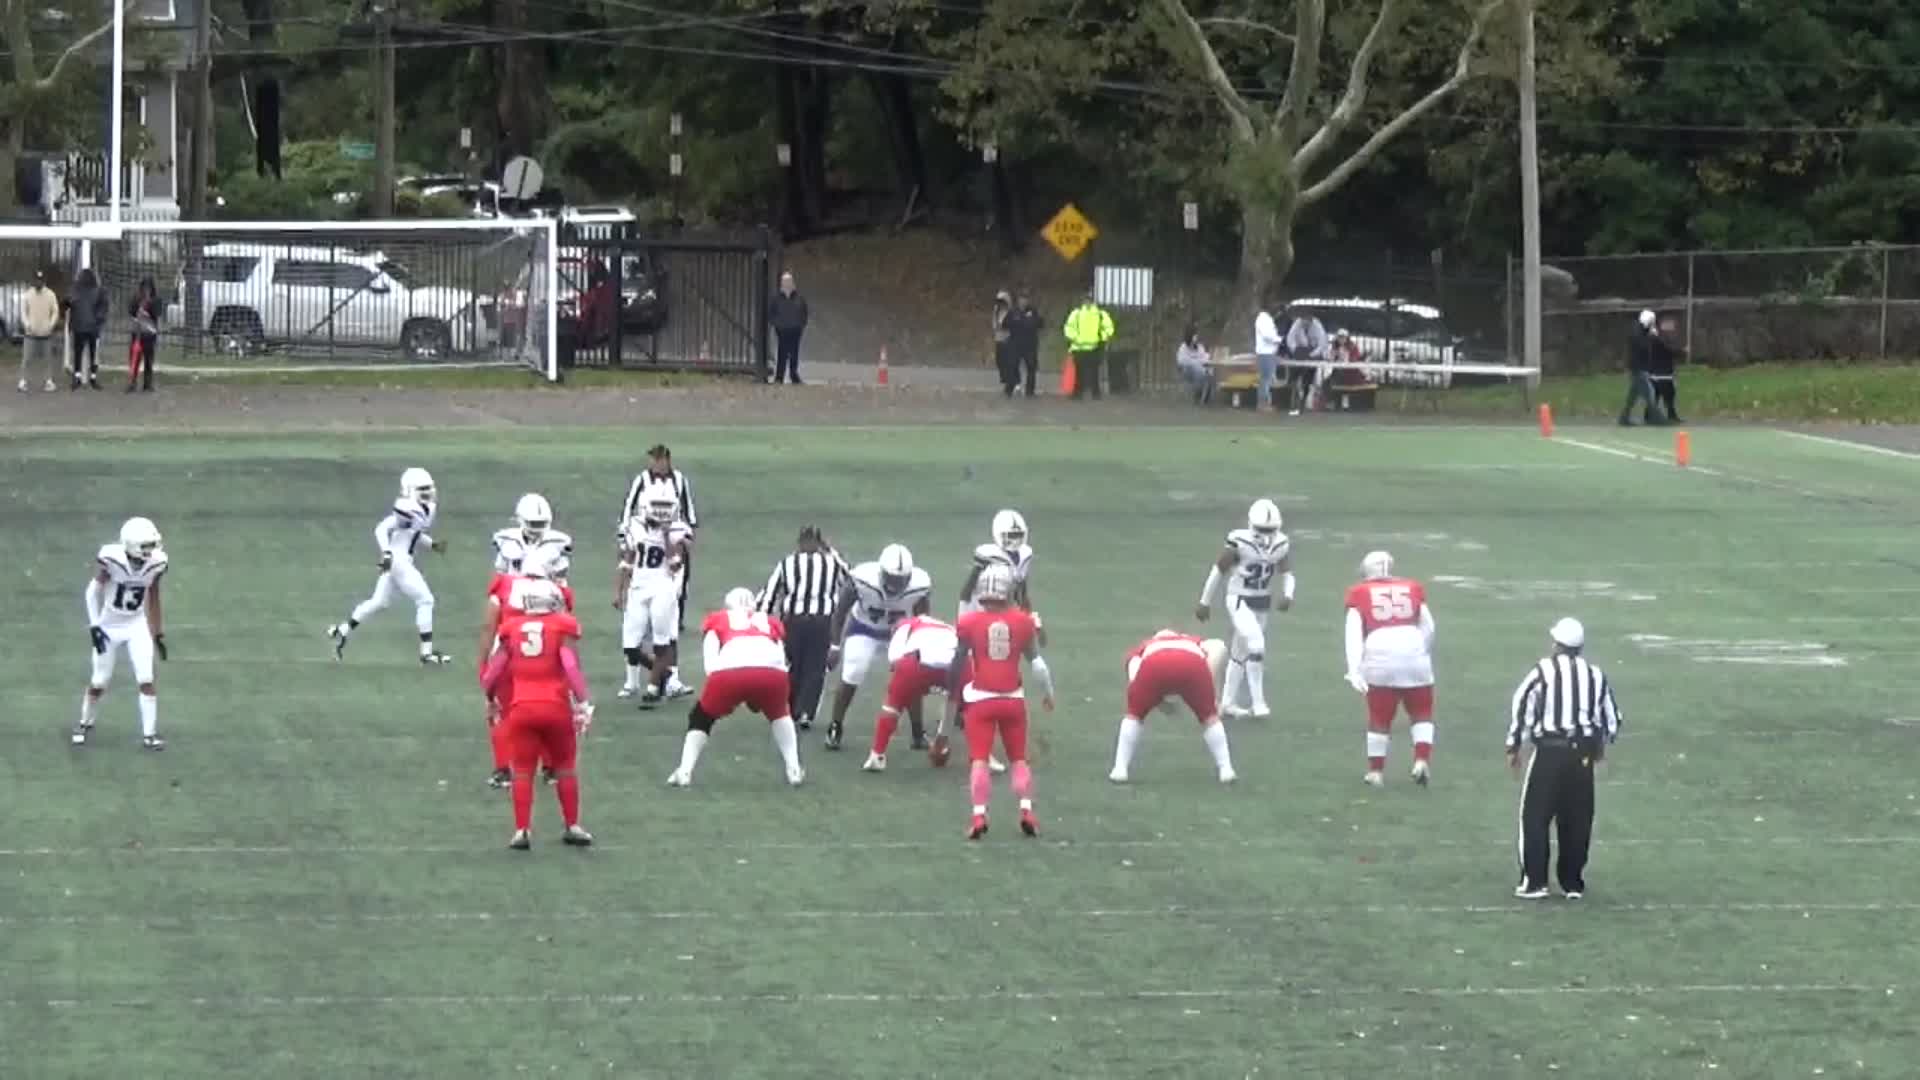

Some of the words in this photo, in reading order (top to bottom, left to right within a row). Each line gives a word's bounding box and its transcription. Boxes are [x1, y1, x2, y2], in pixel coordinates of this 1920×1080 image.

[637, 542, 665, 569] 18
[113, 582, 146, 611] 13
[1370, 585, 1412, 621] 55
[520, 621, 543, 657] 3
[987, 621, 1010, 661] 8
